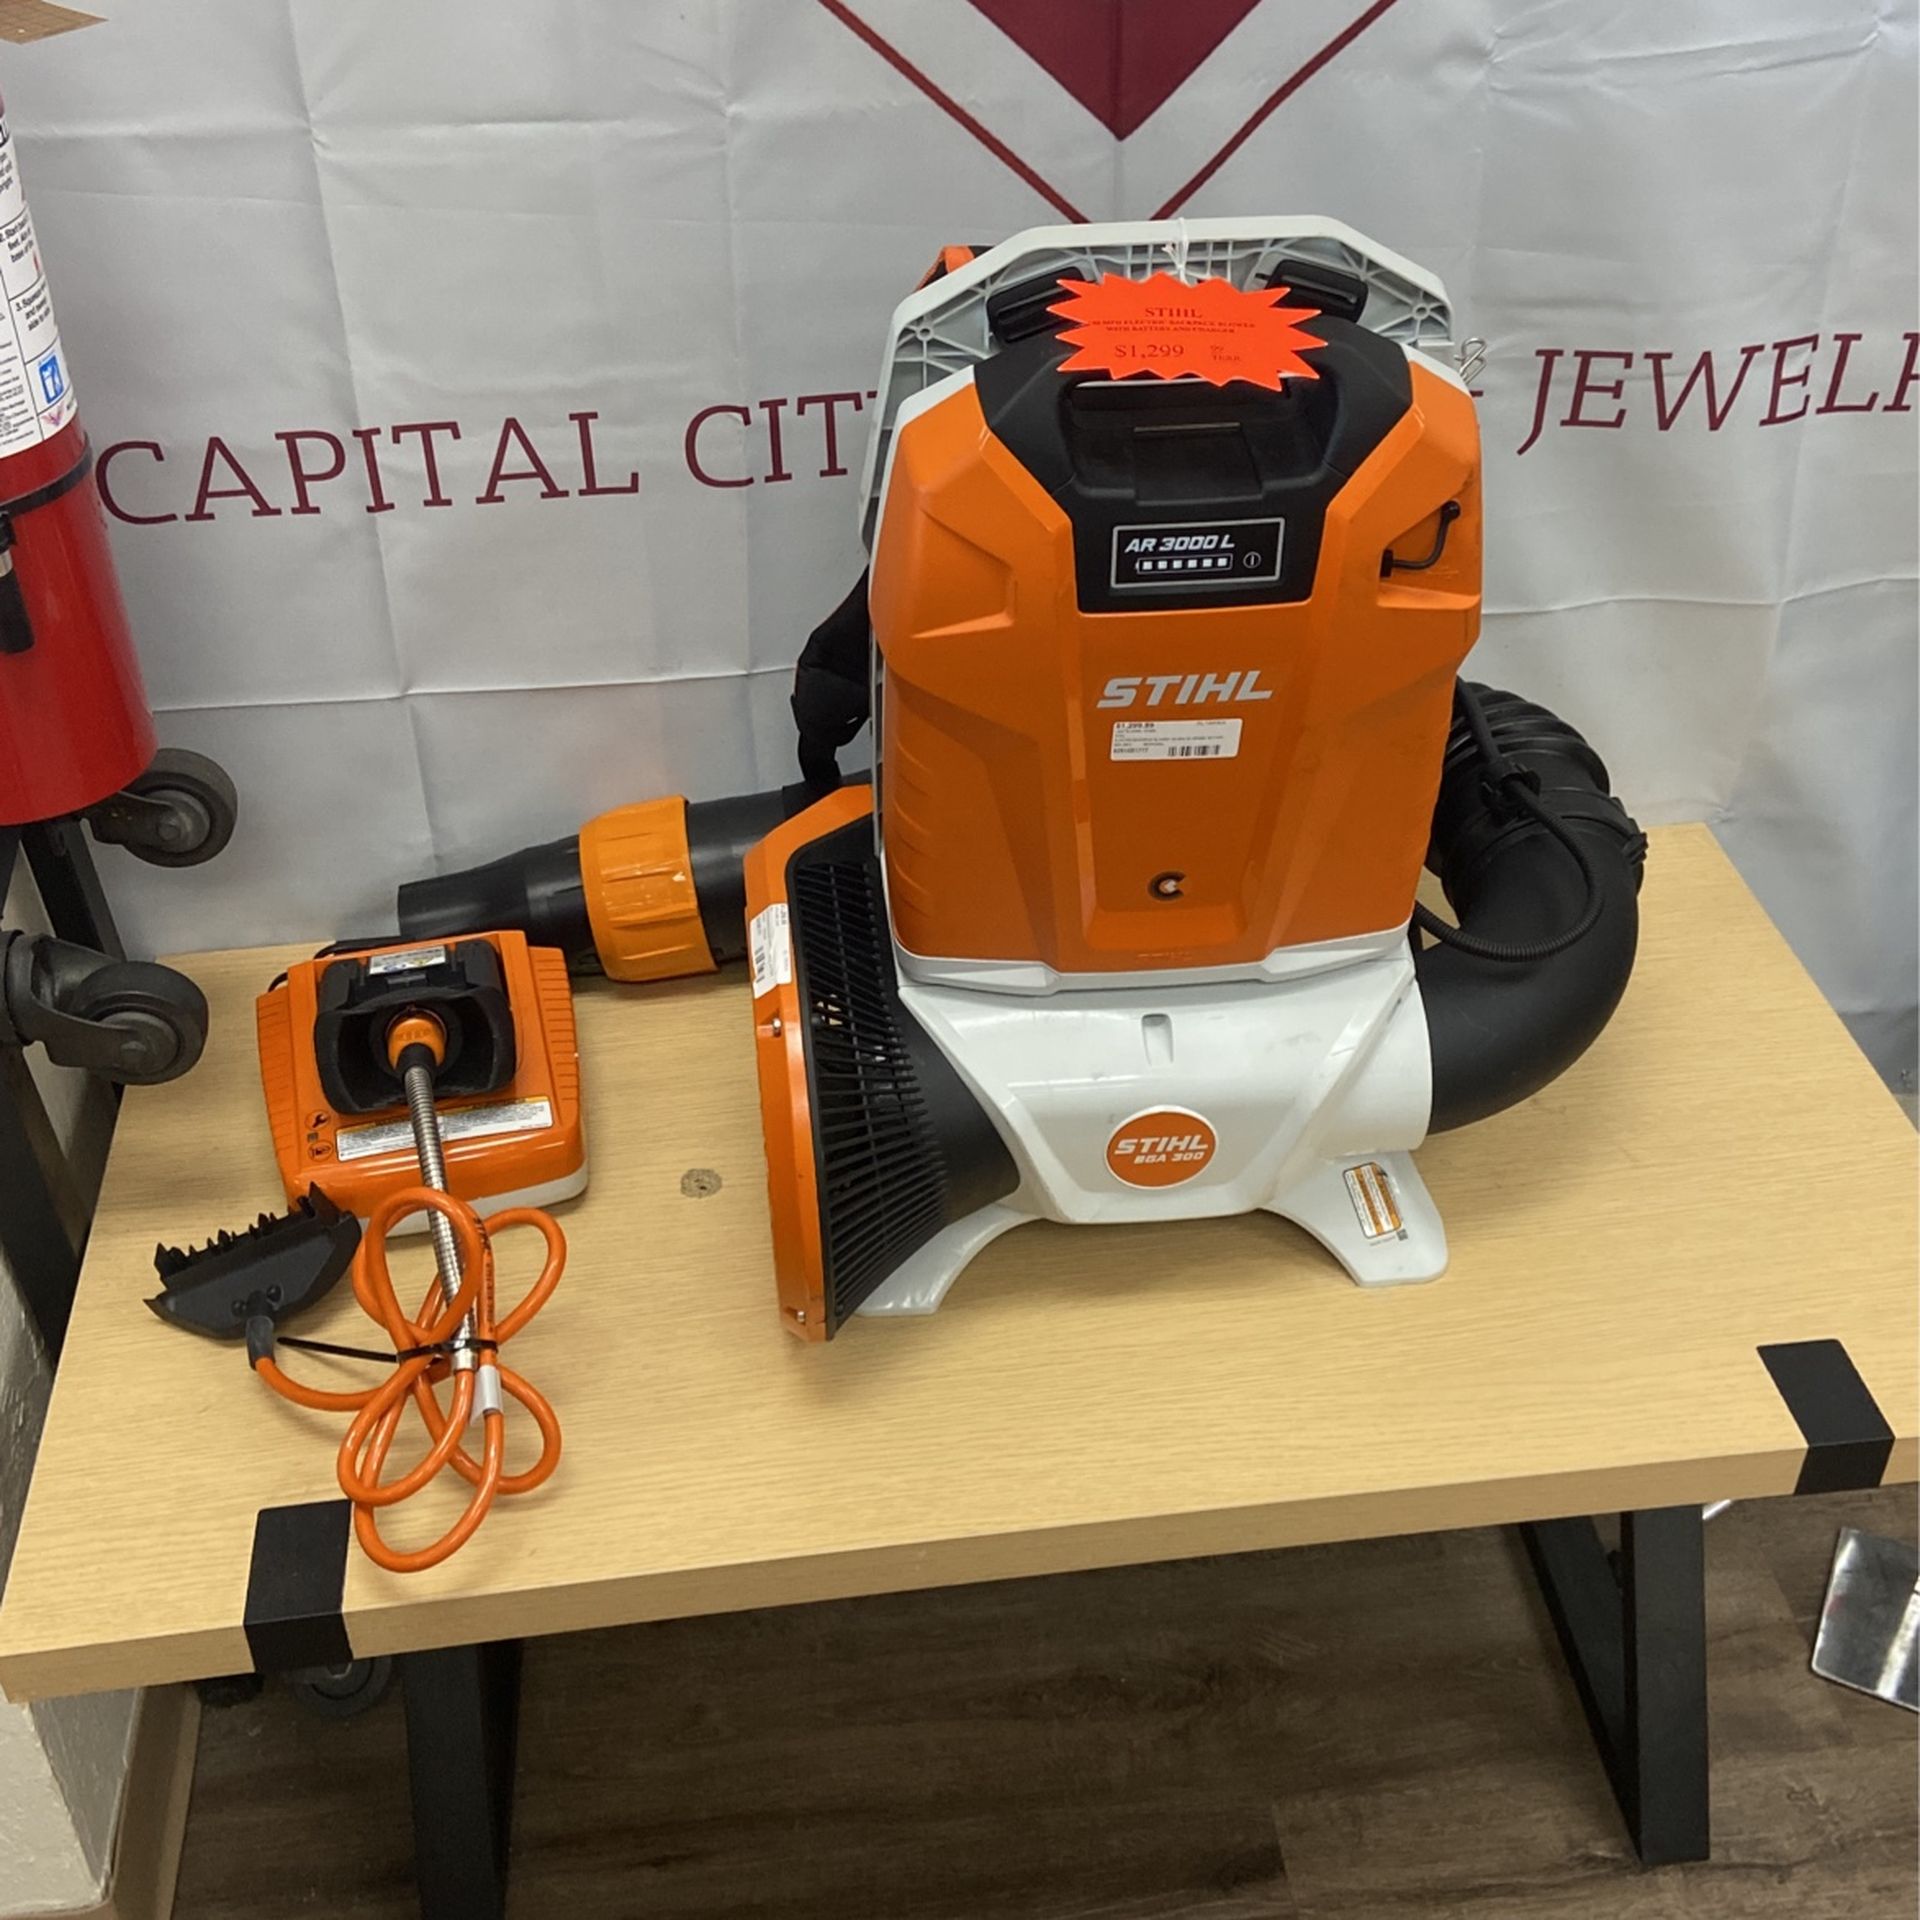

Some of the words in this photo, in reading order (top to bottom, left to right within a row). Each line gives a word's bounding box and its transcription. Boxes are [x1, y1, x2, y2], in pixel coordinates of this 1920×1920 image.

[1144, 307, 1203, 319] STIHL
[1114, 344, 1185, 359] $1,299
[95, 411, 640, 525] CAPITAL
[684, 390, 878, 488] CIT
[1124, 537, 1157, 553] AR
[1158, 534, 1219, 552] 3000
[1220, 534, 1236, 549] L
[1096, 670, 1273, 709] STIHL
[1114, 1134, 1209, 1155] STIHL
[1133, 1154, 1167, 1165] BGA
[1171, 1151, 1205, 1162] 300
